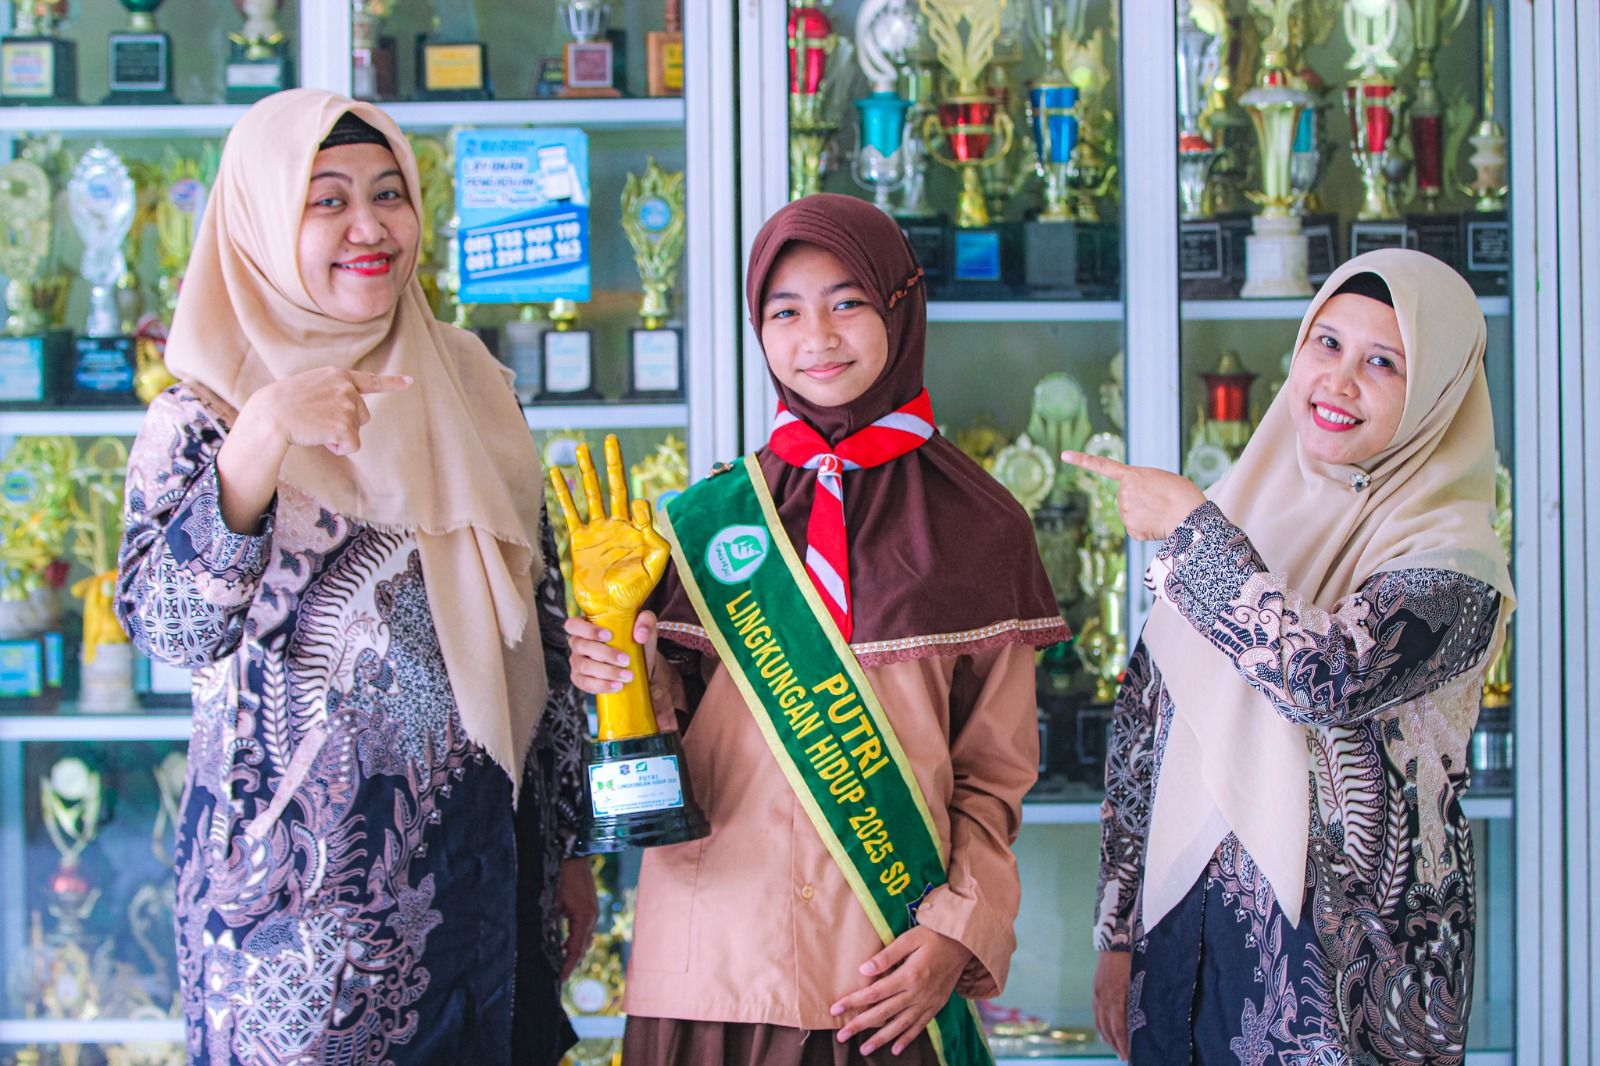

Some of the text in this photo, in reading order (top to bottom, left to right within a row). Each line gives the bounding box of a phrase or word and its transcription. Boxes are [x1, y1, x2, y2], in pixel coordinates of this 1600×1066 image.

[725, 590, 911, 897] LINGKUNGAN HIDUP 2025 SD
[812, 672, 890, 780] PUTRI
